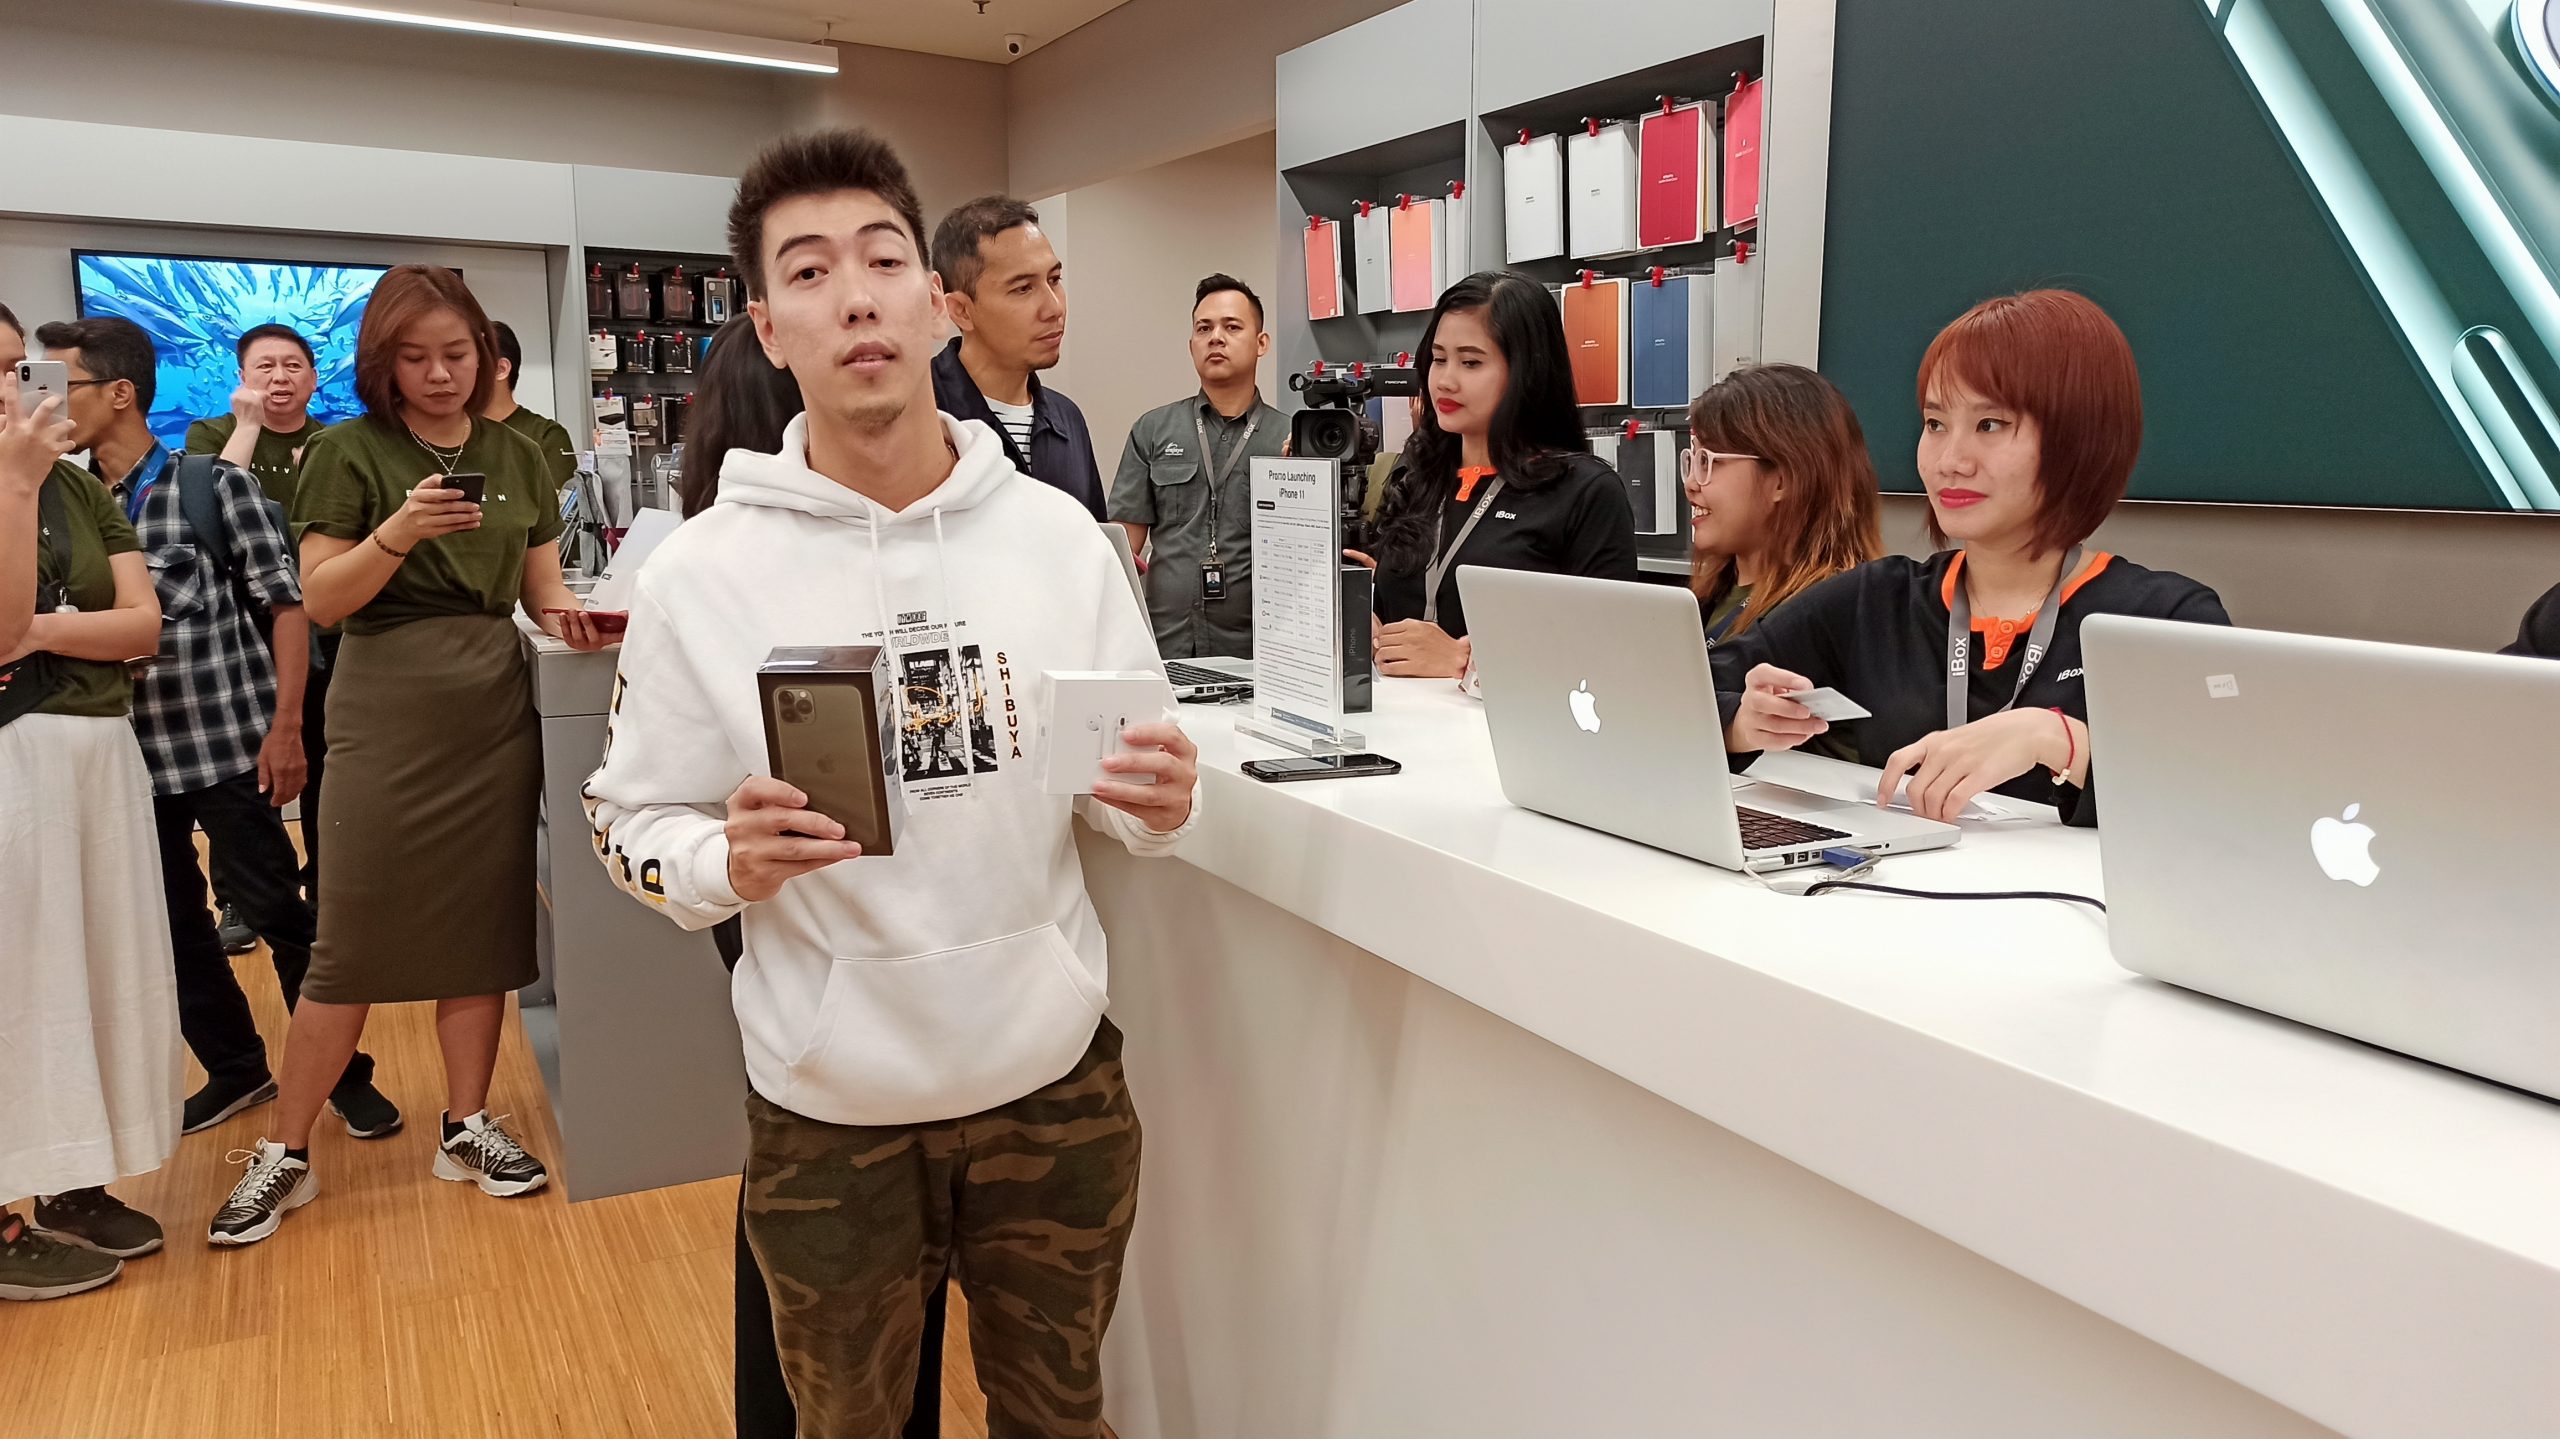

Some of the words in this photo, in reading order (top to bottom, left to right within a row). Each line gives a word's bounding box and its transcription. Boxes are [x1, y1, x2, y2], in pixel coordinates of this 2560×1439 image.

[250, 462, 290, 475] ELEV
[1268, 469, 1286, 481] Promo
[1287, 471, 1316, 485] Launching
[1279, 487, 1298, 499] iPhone
[1299, 489, 1305, 499] 11
[1472, 493, 1494, 519] iBox
[908, 625, 930, 634] DECIDE
[930, 623, 943, 631] OUR
[1349, 627, 1357, 657] iPhone
[1951, 637, 1967, 677] iBox
[2019, 643, 2043, 685] iBox
[996, 651, 1022, 759] SHIBUYA
